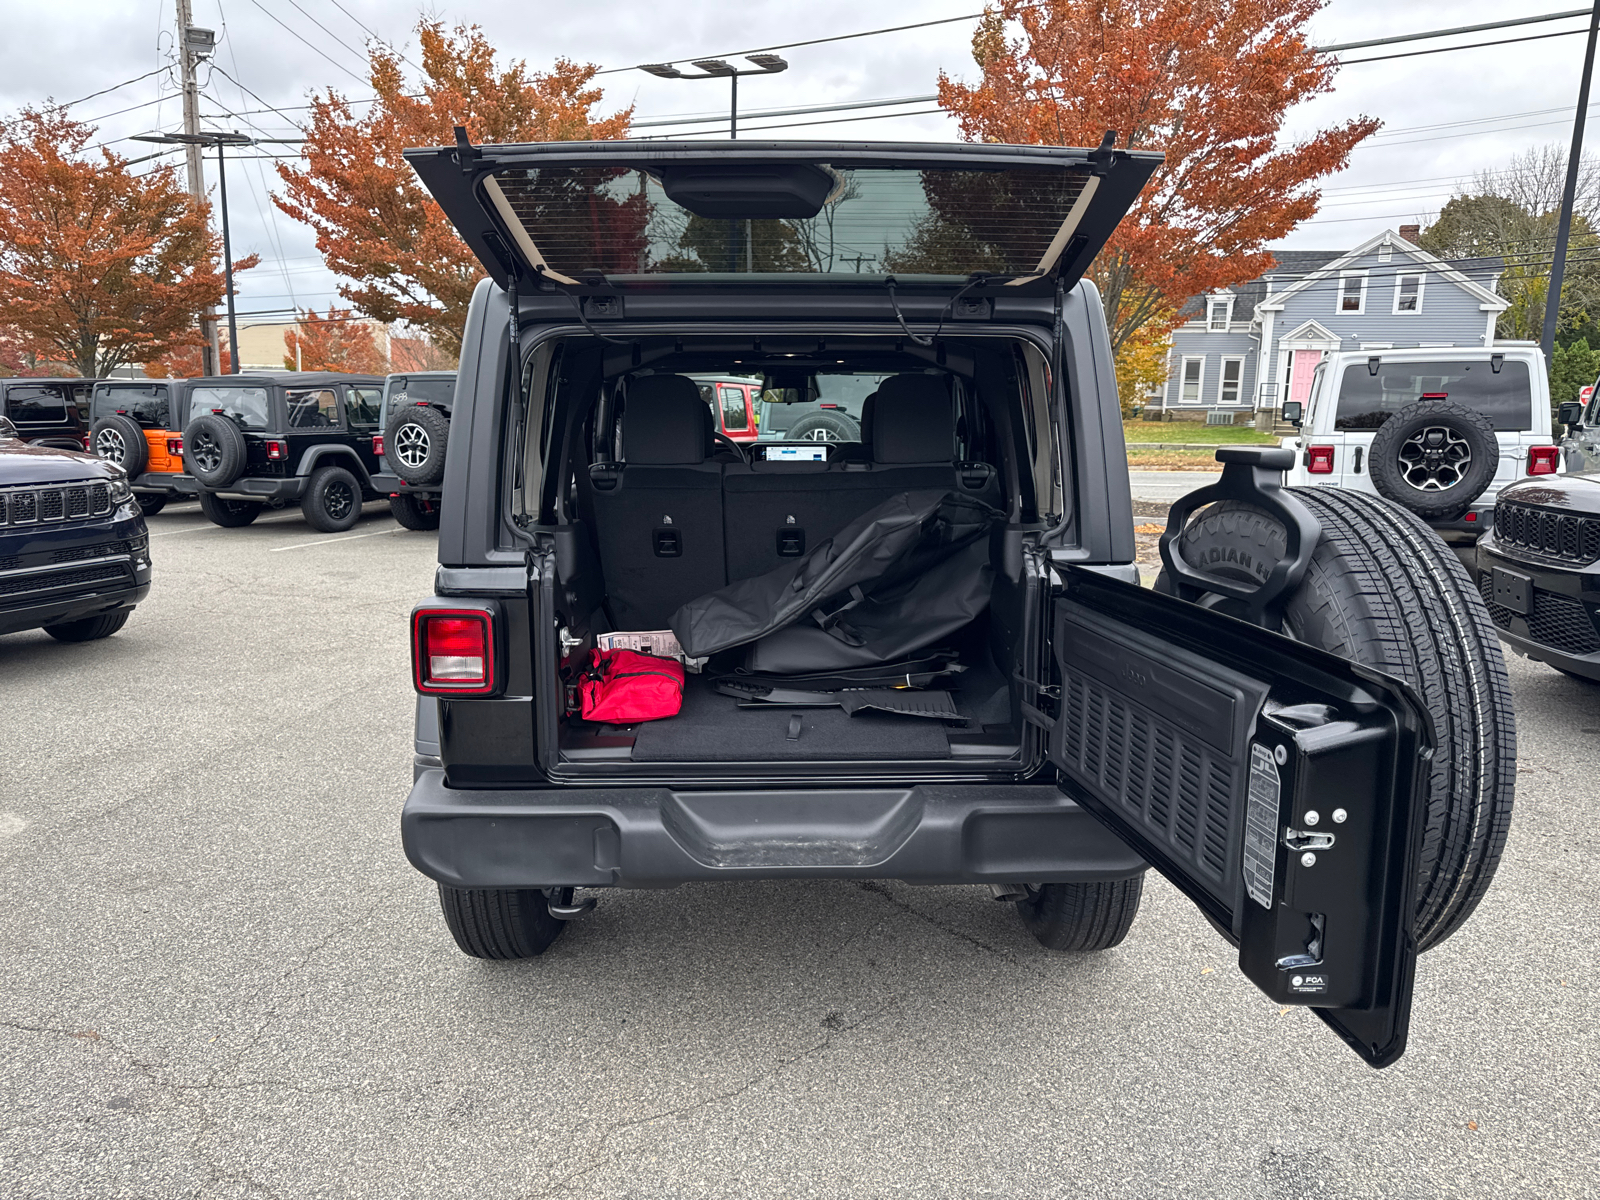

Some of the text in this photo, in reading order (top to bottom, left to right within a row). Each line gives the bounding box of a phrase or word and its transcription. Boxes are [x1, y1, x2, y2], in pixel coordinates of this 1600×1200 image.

[391, 392, 408, 403] 1588
[1121, 663, 1146, 688] Jeep
[1257, 748, 1267, 757] Jeep
[1253, 759, 1276, 775] JL
[1256, 867, 1271, 881] USA
[1305, 976, 1323, 984] FCA
